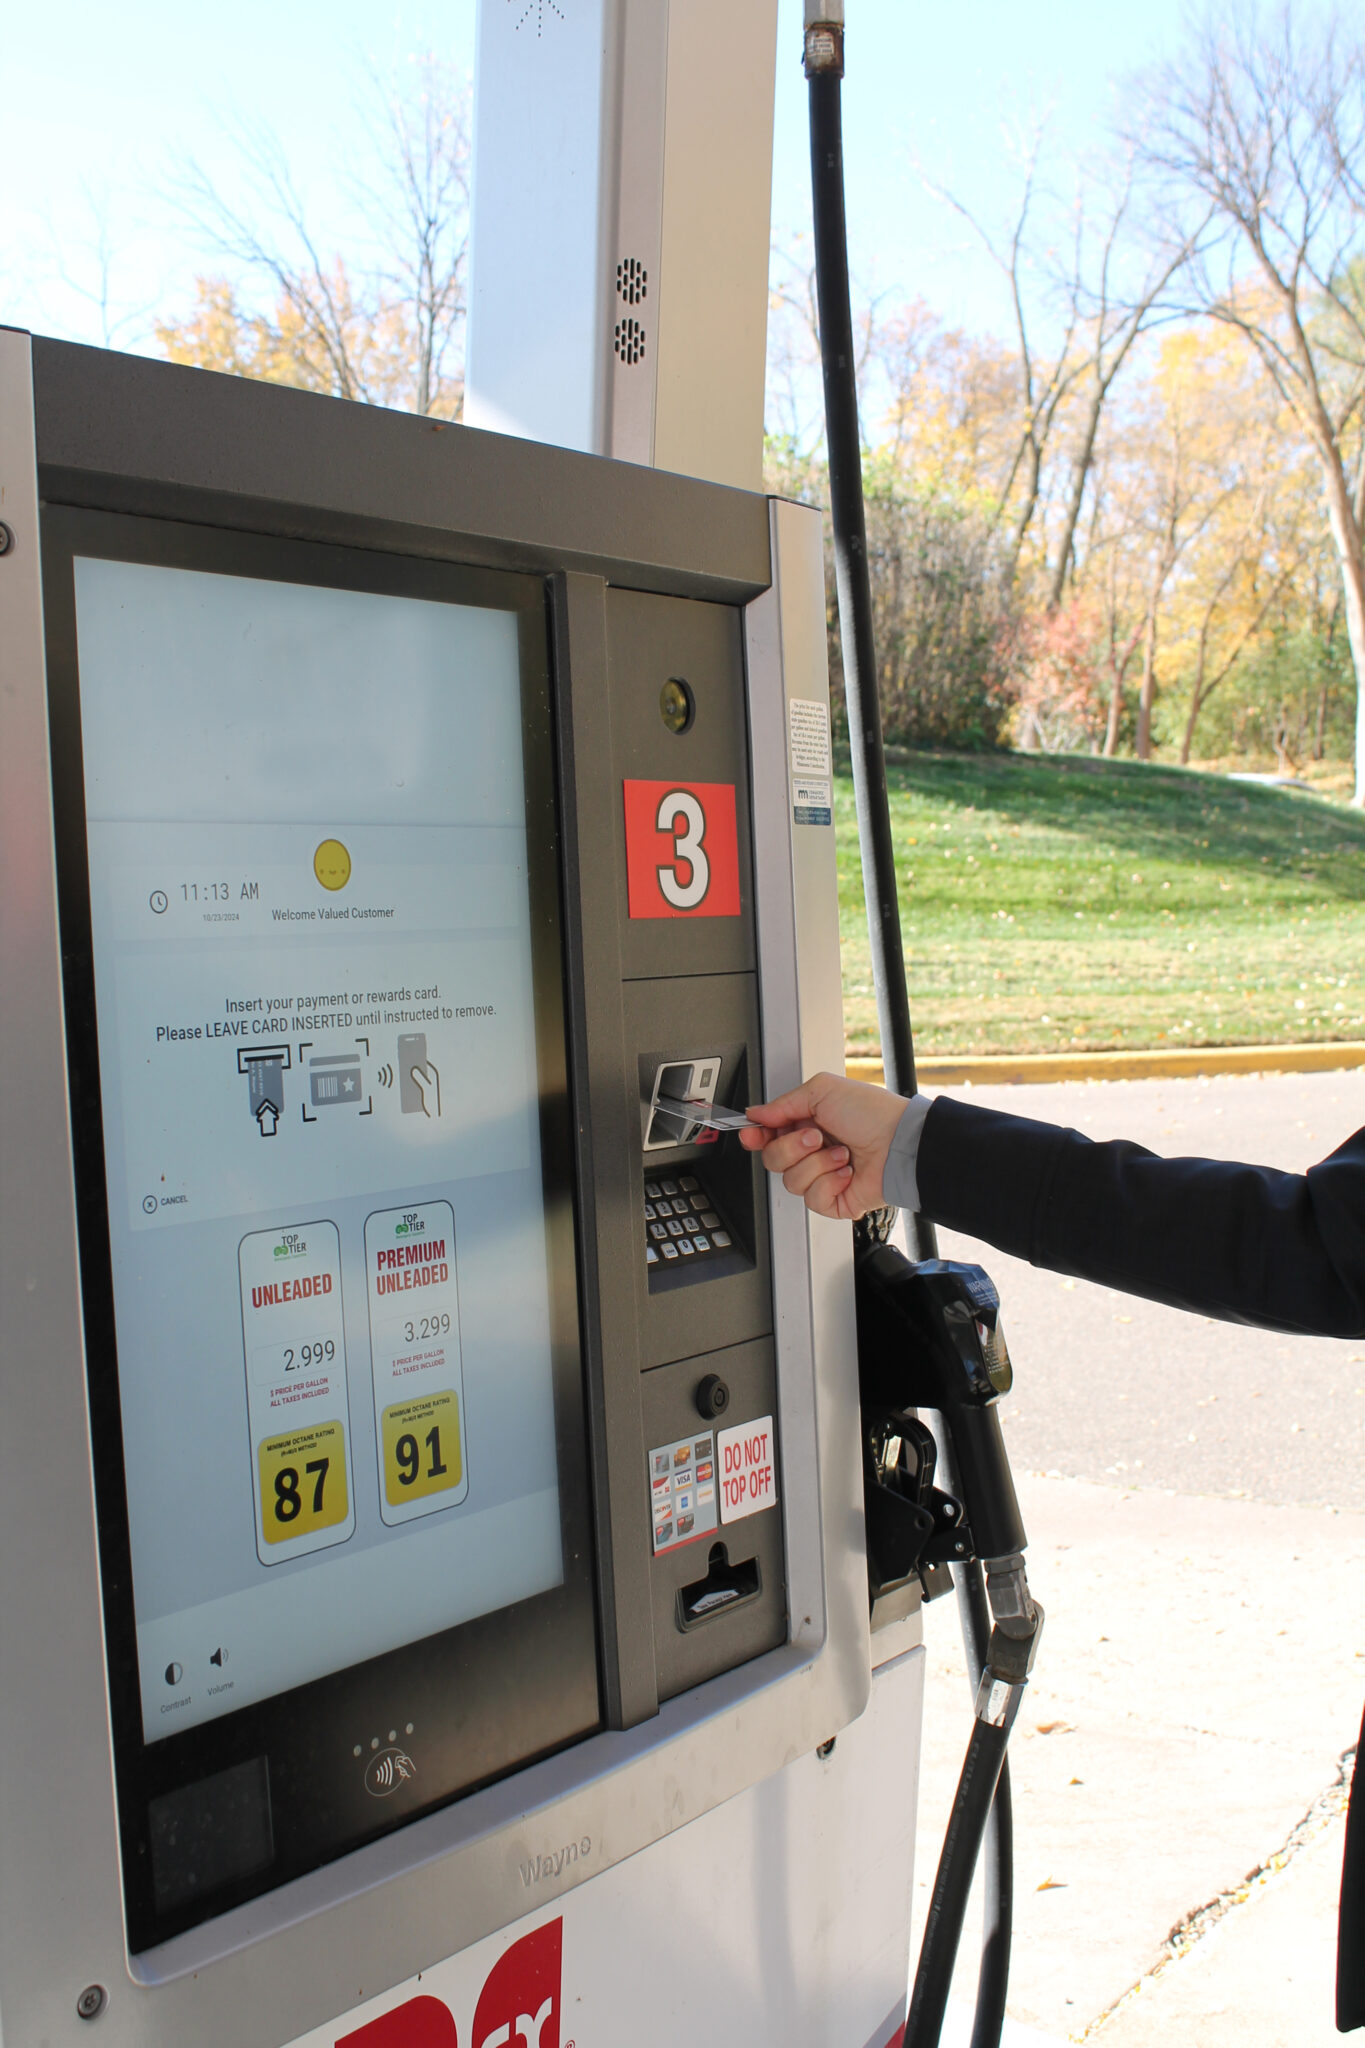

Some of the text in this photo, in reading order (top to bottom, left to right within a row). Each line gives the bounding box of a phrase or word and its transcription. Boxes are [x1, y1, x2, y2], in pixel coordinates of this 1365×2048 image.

[655, 787, 711, 911] 3
[180, 882, 260, 901] 11:13 AM
[202, 912, 240, 922] 10/23/2024
[272, 907, 395, 921] Welcome Valued Customer
[225, 985, 442, 1014] Insert your payment or rewards card.
[156, 1004, 497, 1042] Please LEAVE CARD INSERTED until instructed to remove.
[161, 1195, 188, 1206] CANCEL
[403, 1213, 418, 1224] TOP
[409, 1221, 425, 1232] TIER
[281, 1234, 299, 1245] TOP
[289, 1242, 307, 1254] TIER
[377, 1239, 446, 1271] PREMIUM
[376, 1263, 449, 1296] UNLEADED
[252, 1273, 333, 1308] UNLEADED
[404, 1313, 451, 1342] 3.299
[283, 1340, 335, 1371] 2.999
[396, 1356, 412, 1366] PRICE
[412, 1354, 424, 1362] PER
[424, 1349, 445, 1359] GALLON
[392, 1369, 402, 1377] ALL
[403, 1364, 420, 1374] TAXES
[275, 1385, 293, 1396] PRICE
[293, 1383, 305, 1391] PER
[305, 1377, 329, 1388] GALLON
[270, 1387, 330, 1408] ALL TAXES INCLUDED
[389, 1407, 412, 1419] MINIMUM
[412, 1401, 433, 1413] OCTANE
[266, 1428, 335, 1452] MINIMUM OCTANE RATING
[395, 1425, 448, 1486] 91
[724, 1433, 768, 1474] DO NOT
[676, 1473, 691, 1485] VISA
[722, 1465, 771, 1508] TOP OFF
[274, 1457, 330, 1523] 87
[207, 1681, 235, 1696] Volume
[160, 1695, 192, 1714] Contrast
[518, 1835, 592, 1888] Wayne
